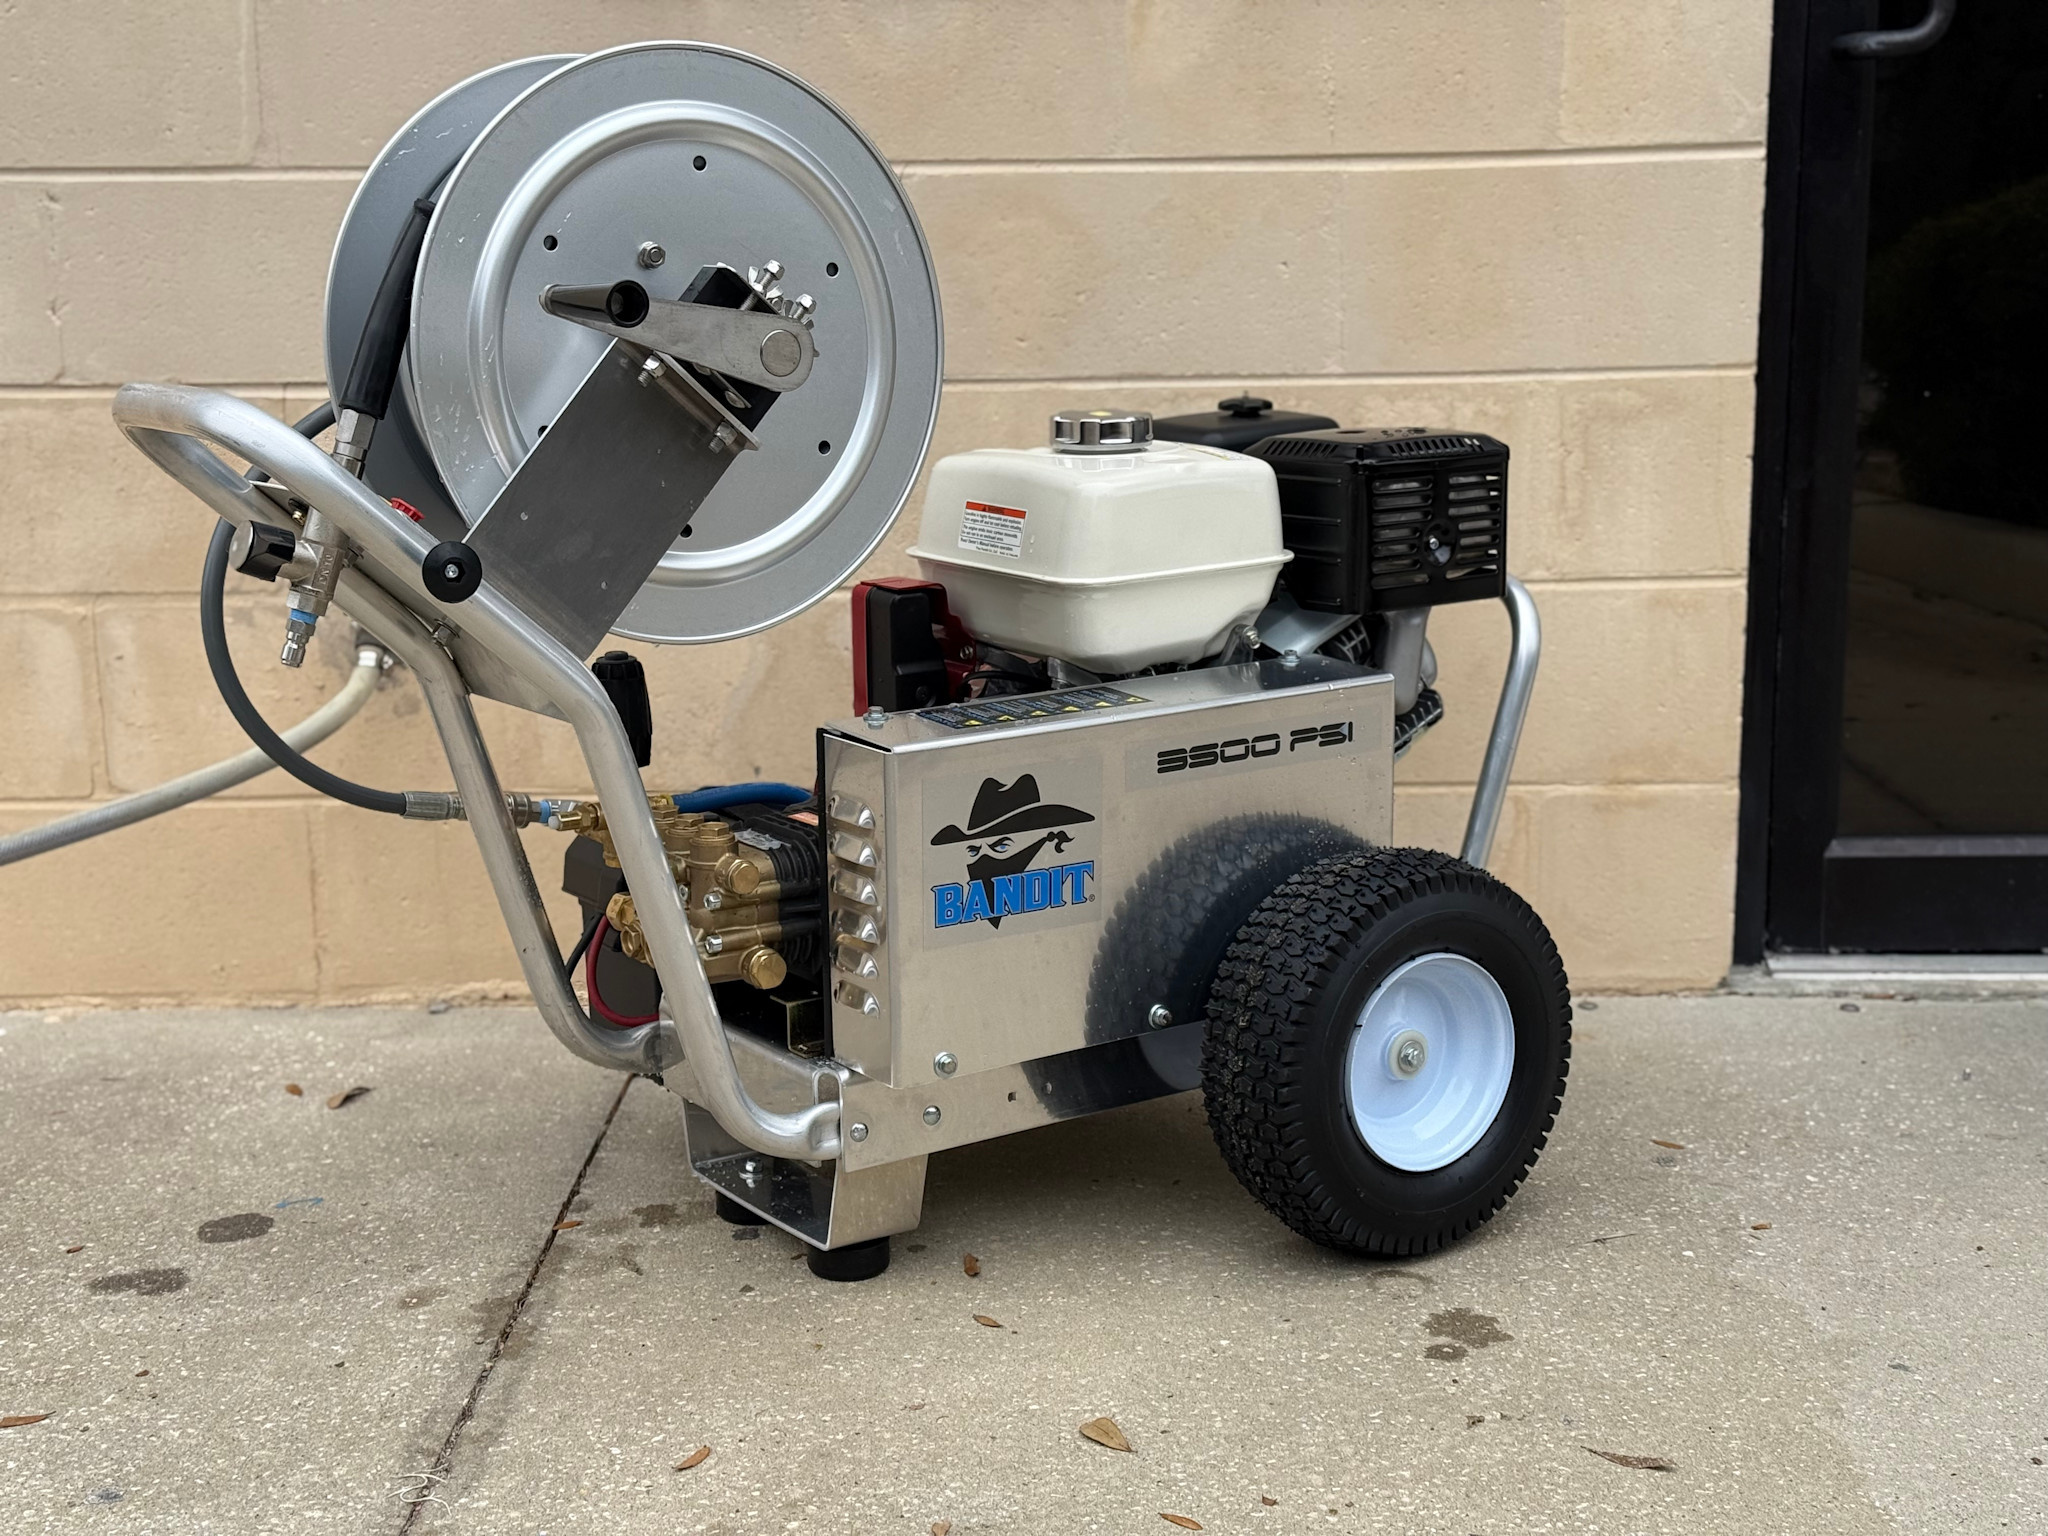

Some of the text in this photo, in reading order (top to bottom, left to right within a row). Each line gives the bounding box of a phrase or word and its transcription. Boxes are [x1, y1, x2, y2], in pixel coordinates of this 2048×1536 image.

[1157, 721, 1354, 774] 3500 PSI
[930, 860, 1095, 929] BANDIT
